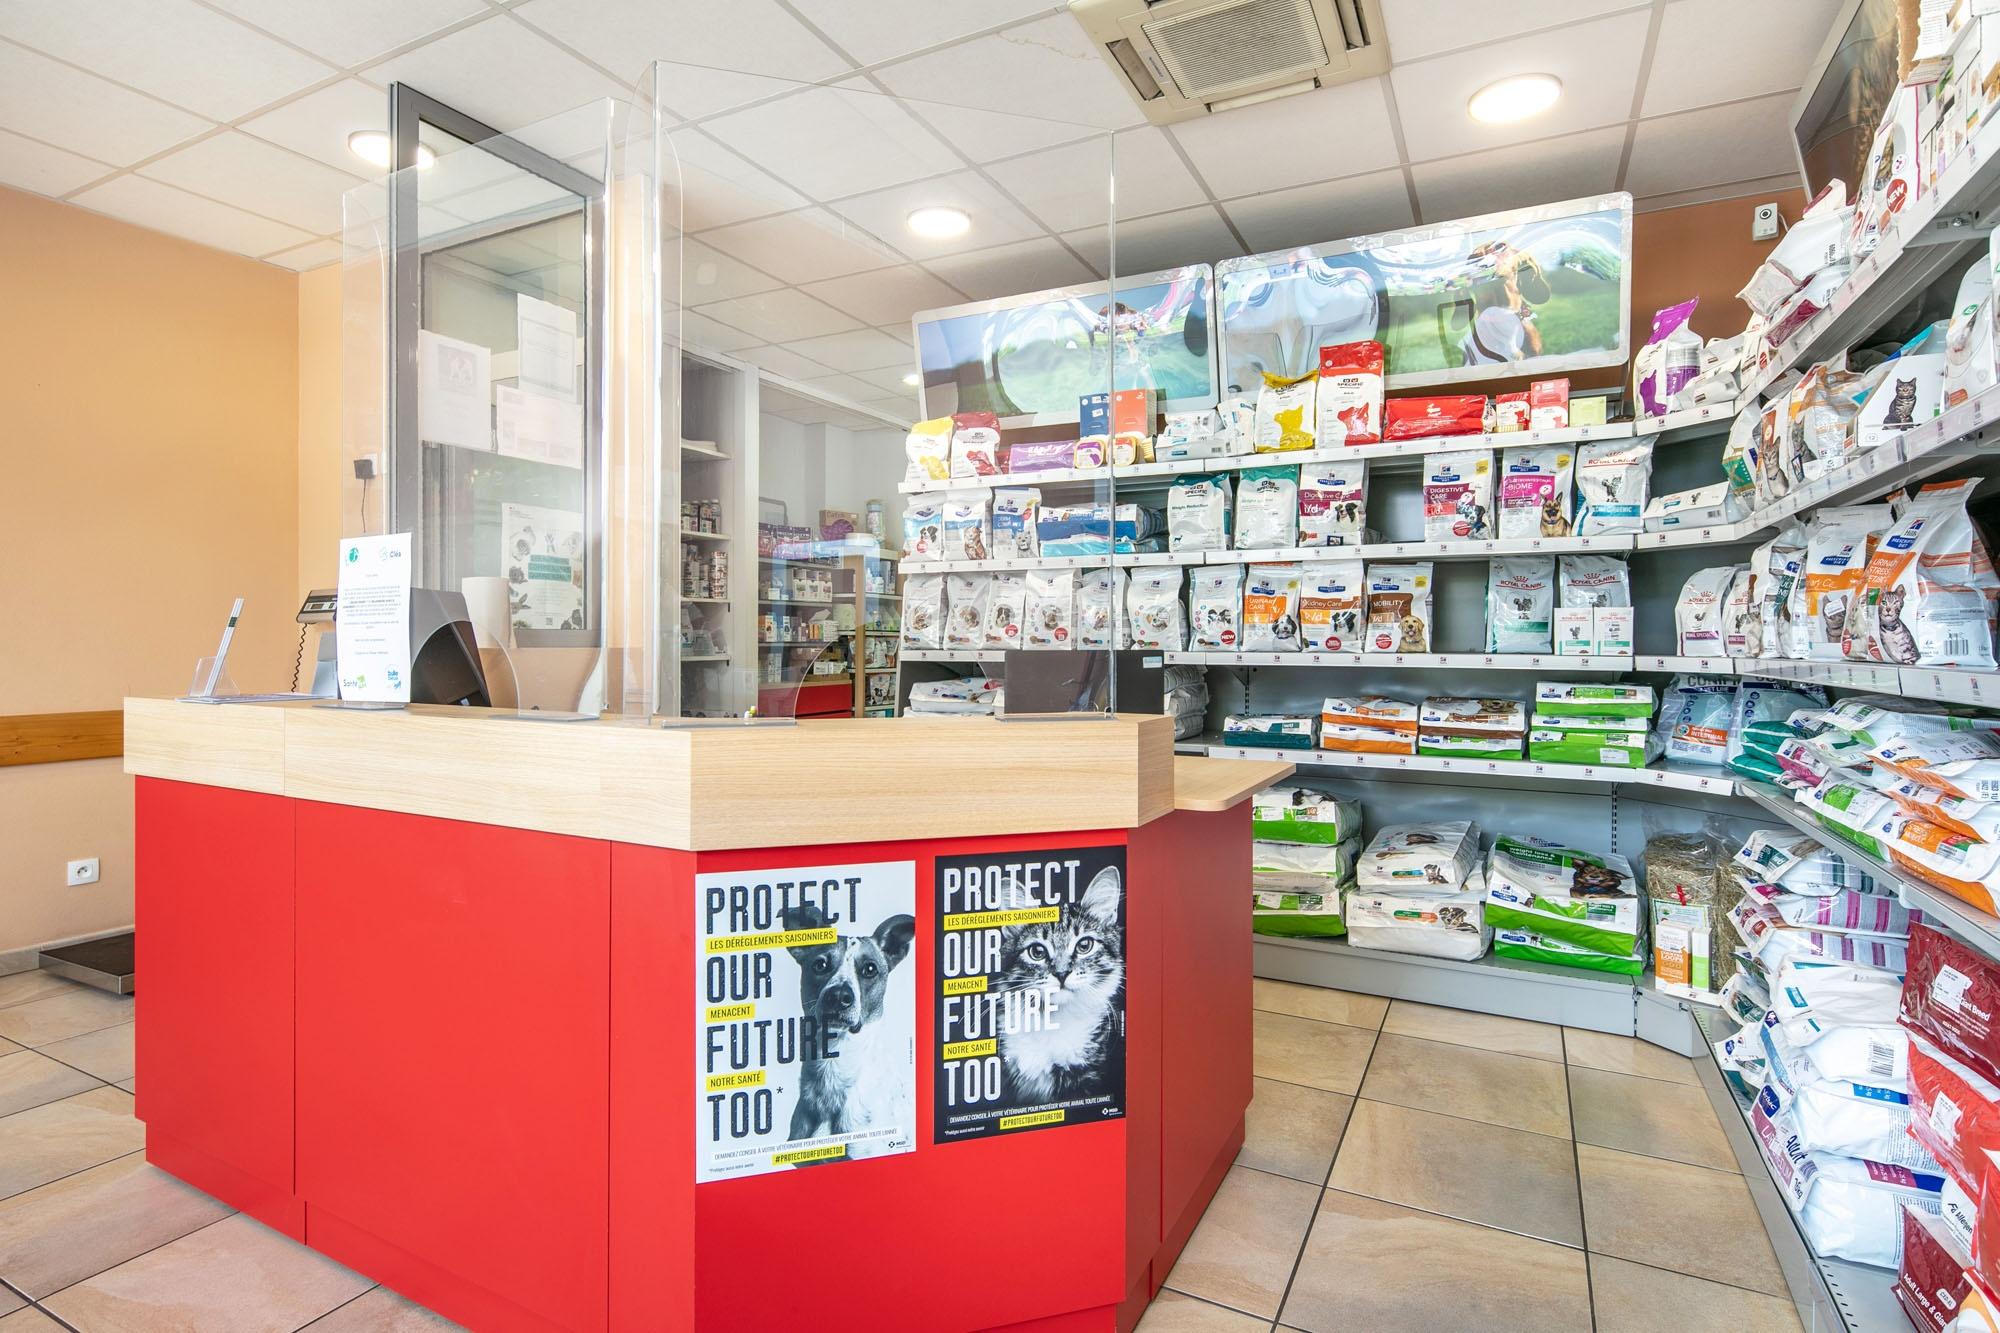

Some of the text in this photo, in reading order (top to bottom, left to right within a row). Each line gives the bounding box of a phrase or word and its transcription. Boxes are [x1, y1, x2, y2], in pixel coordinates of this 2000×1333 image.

[1887, 183, 1905, 206] NEW
[1508, 482, 1534, 490] BIOME
[1593, 576, 1616, 584] CANIN
[1510, 851, 1553, 860] maintenance
[943, 860, 1080, 912] PROTECT
[706, 876, 861, 934] PROTECT
[948, 918, 960, 926] LES
[1014, 910, 1056, 921] SAISONNIERS
[710, 940, 724, 950] LES
[785, 931, 834, 943] SAISONNIERS
[943, 929, 1001, 977] OUR
[706, 952, 772, 1003] OUR
[947, 980, 983, 990] MENACENT
[710, 1006, 750, 1019] MENACENT
[943, 986, 1060, 1042] FUTURE
[1972, 1006, 1991, 1022] Breed
[706, 1013, 840, 1073] FUTURE
[947, 1042, 992, 1055] NOTRE SANTÉ
[710, 1073, 761, 1087] NOTRE SANTÉ
[950, 1114, 971, 1124] DEMANDEZ
[972, 1112, 988, 1120] CONSEIL
[1004, 1107, 1027, 1116] VÉTÉRINAIRE
[1039, 1102, 1058, 1111] PROTÉGER
[1002, 1111, 1062, 1128] #PROTECTOURFUTURETOO
[714, 1152, 738, 1160] DEMANDEZ
[739, 1148, 756, 1156] CONSEIL
[776, 1142, 802, 1151] VÉTÉRINAIRE
[816, 1136, 838, 1145] PROTÉGER
[852, 1132, 868, 1140] ANIMAL
[869, 1130, 881, 1138] TOUTE
[775, 1146, 843, 1163] #PROTECTOURFUTURETOO
[1786, 1135, 1808, 1164] Adult
[1956, 1212, 1972, 1234] Allergen
[1904, 1273, 1946, 1327] Adult Large & Gian
